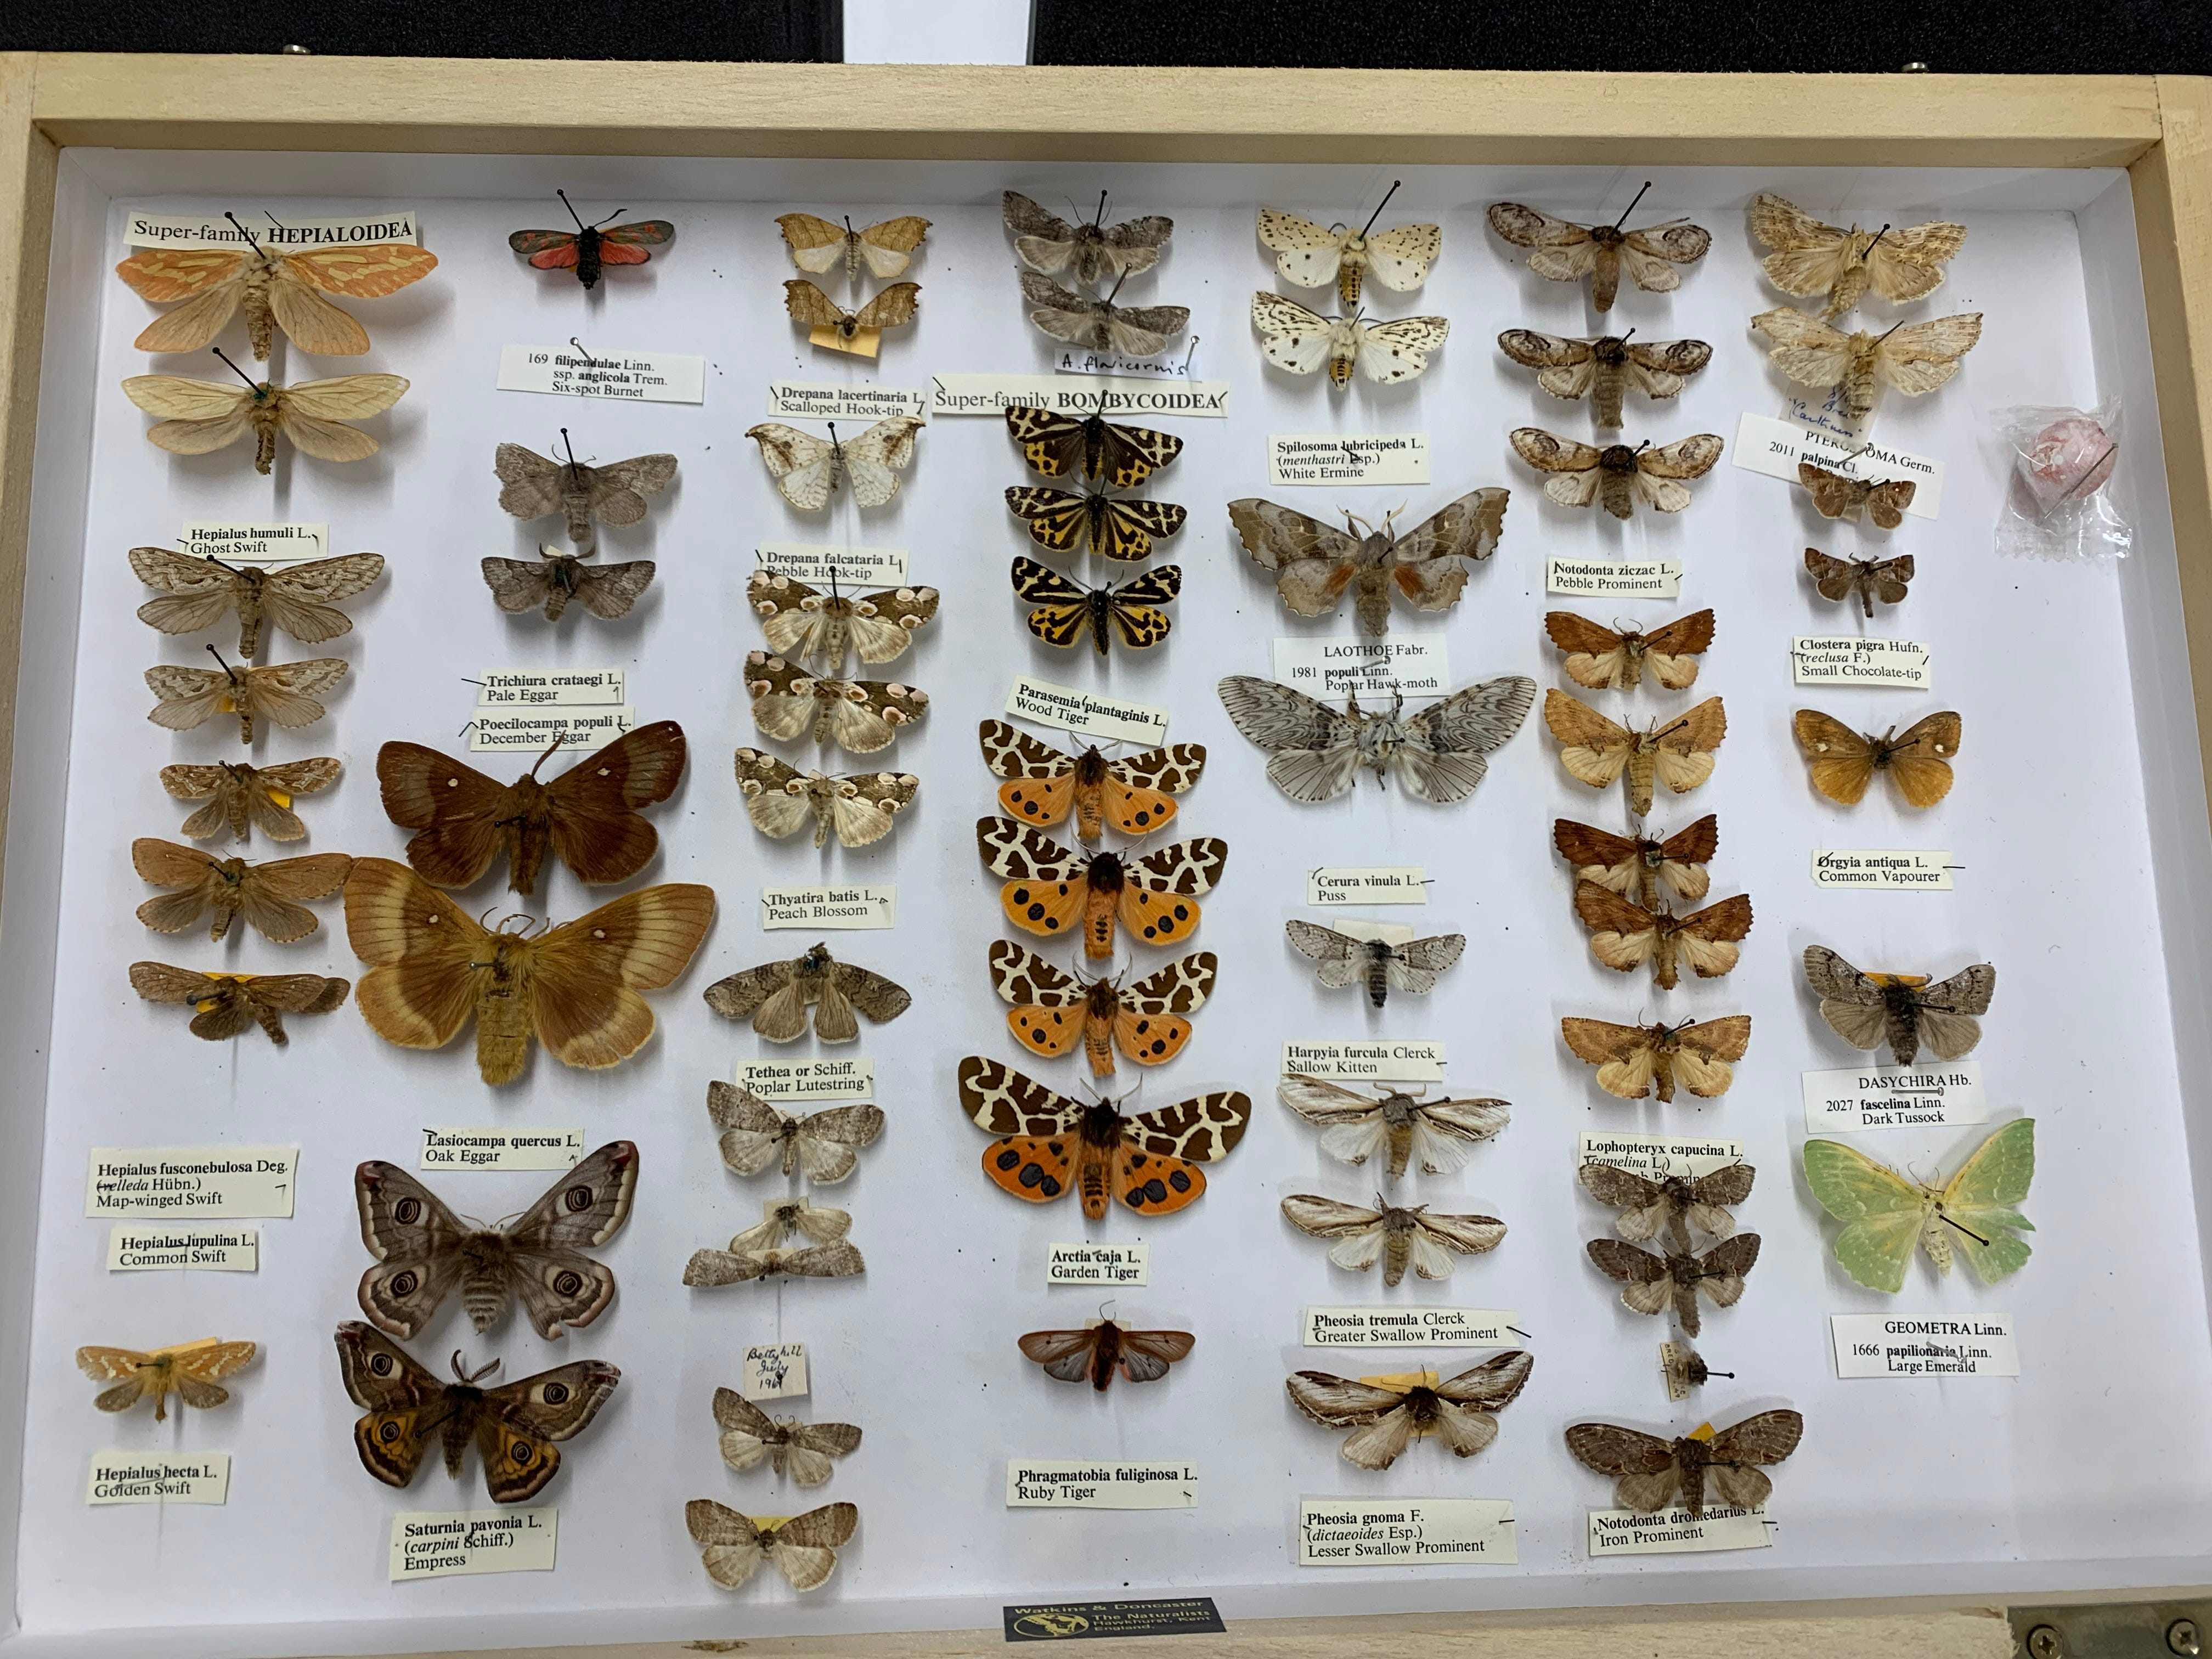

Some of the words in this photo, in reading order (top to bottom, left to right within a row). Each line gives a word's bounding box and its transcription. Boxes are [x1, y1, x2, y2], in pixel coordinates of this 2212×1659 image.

[134, 221, 261, 245] Super-family
[267, 221, 413, 244] HEPIALOIDEA
[528, 353, 548, 364] 169
[555, 355, 621, 370] filipendulae
[624, 359, 654, 371] Linn.
[554, 371, 575, 381] ssp.
[578, 371, 630, 384] anglicola
[634, 374, 667, 386] Trem.
[552, 382, 600, 396] Six-spot
[603, 386, 644, 397] Burnet
[782, 387, 833, 401] Drepana
[838, 390, 907, 403] lacertinaria
[935, 390, 1049, 410] Super-family
[1057, 392, 1219, 409] BOMBYCOIDEA
[781, 401, 841, 414] Scalloped
[847, 404, 903, 416] Hook-tip
[1278, 442, 1338, 454] Spilosoma
[1769, 442, 1794, 456] 2011
[1802, 453, 1840, 469] palpina
[1278, 455, 1345, 466] (menthastri
[1900, 456, 1935, 473] Germ.
[1278, 469, 1316, 479] White
[1320, 468, 1364, 478] Ermine
[191, 528, 247, 542] Hepialus
[250, 527, 293, 539] humuli
[190, 543, 230, 554] Ghost
[234, 541, 267, 553] Swift
[767, 552, 819, 565] Drepana
[824, 553, 884, 565] falcataria
[1554, 562, 1613, 575] Notodonta
[1619, 565, 1655, 575] ziczac
[1556, 577, 1593, 588] Pebble
[1598, 579, 1662, 589] Prominent
[1324, 646, 1392, 658] LAOTHOE
[1396, 645, 1427, 655] Fabr.
[1800, 639, 1851, 652] Clostera
[1856, 640, 1884, 654] pigra
[1889, 641, 1922, 653] Hufn.
[1854, 653, 1871, 664] F.)
[487, 675, 546, 687] Trichiura
[551, 674, 602, 686] crataegi
[1291, 667, 1317, 678] 1981
[1324, 668, 1358, 679] populi
[1802, 666, 1837, 676] Small
[1842, 665, 1921, 681] Chocolate-tip
[1367, 679, 1437, 690] Hawk-moth
[487, 690, 515, 701] Pale
[519, 689, 558, 702] Eggar
[1015, 697, 1052, 715] Wood
[1058, 708, 1089, 725] Tiger
[1018, 684, 1080, 709] Parasemia
[1085, 703, 1149, 724] plantaginis
[479, 719, 568, 732] Poecilocampa
[573, 716, 612, 730] populi
[479, 734, 546, 744] December
[1865, 857, 1910, 869] antiqua
[1318, 877, 1359, 887] Cerura
[1364, 876, 1401, 886] vinula
[1819, 872, 1877, 882] Common
[1883, 871, 1939, 883] Vapourer
[769, 894, 823, 906] Thyatira
[829, 891, 859, 904] batis
[1318, 890, 1346, 901] Puss
[769, 907, 808, 920] Peach
[813, 906, 867, 917] Blossom
[1288, 1047, 1339, 1059] Harpyia
[1345, 1047, 1388, 1058] furcula
[1393, 1047, 1435, 1059] Clerck
[746, 1066, 790, 1079] Tethea
[795, 1066, 810, 1076] or
[814, 1062, 855, 1075] Schiff.
[1288, 1061, 1331, 1073] Sallow
[1337, 1062, 1377, 1073] Kitten
[746, 1081, 791, 1094] Poplar
[795, 1078, 864, 1092] Lutestring
[1859, 1075, 1946, 1090] DASYCHIRA
[1949, 1075, 1971, 1085] Hb.
[1826, 1100, 1853, 1111] 2027
[1861, 1099, 1910, 1110] fascelina
[1914, 1097, 1945, 1108] Linn.
[1863, 1114, 1893, 1124] Dark
[1894, 1112, 1945, 1123] Tussock
[426, 1135, 505, 1147] Lasiocampa
[511, 1137, 561, 1147] quercus
[1587, 1140, 1666, 1155] Lophopteryx
[1671, 1144, 1725, 1157] capucina
[425, 1151, 454, 1162] Oak
[461, 1151, 500, 1164] Eggar
[98, 1163, 156, 1177] Hepialus
[160, 1161, 252, 1175] fusconebulosa
[256, 1160, 288, 1175] Deg.
[151, 1177, 201, 1191] Hübn.)
[97, 1194, 182, 1209] Map-winged
[185, 1192, 222, 1205] Swift
[121, 1237, 184, 1250] Hepialus
[187, 1234, 237, 1248] lupulina
[120, 1252, 188, 1266] Common
[191, 1251, 226, 1262] Swift
[1052, 1250, 1091, 1262] Arctia
[1096, 1251, 1121, 1265] caja
[1127, 1251, 1141, 1263] L.
[1052, 1266, 1099, 1278] Garden
[1104, 1266, 1139, 1280] Tiger
[1314, 1314, 1364, 1327] Pheosia
[1370, 1314, 1418, 1325] tremula
[1424, 1312, 1464, 1324] Clerck
[1314, 1330, 1365, 1342] Greater
[1370, 1329, 1425, 1341] Swallow
[1431, 1328, 1498, 1340] Prominent
[1885, 1322, 1971, 1334] GEOMETRA
[1974, 1323, 2006, 1335] Linn.
[1852, 1345, 1880, 1356] 1666
[1888, 1360, 1922, 1373] Large
[1926, 1361, 1976, 1372] Emerald
[97, 1468, 160, 1481] Hepialus
[164, 1465, 199, 1478] hecta
[1018, 1470, 1110, 1484] Phragmatobia
[1116, 1469, 1178, 1482] fuliginosa
[94, 1482, 150, 1498] Golden
[154, 1481, 191, 1494] Swift
[1018, 1487, 1055, 1500] Ruby
[1061, 1486, 1096, 1499] Tiger
[1307, 1513, 1357, 1525] Pheosia
[1362, 1513, 1404, 1525] gnoma
[1410, 1510, 1424, 1522] F.
[1598, 1516, 1666, 1532] Notodonta
[405, 1520, 465, 1537] Saturnia
[470, 1516, 522, 1533] pavonia
[1307, 1528, 1384, 1543] (dictaeoides
[1389, 1525, 1422, 1540] Esp.)
[1600, 1534, 1629, 1547] Iron
[1634, 1528, 1703, 1544] Prominent
[405, 1538, 459, 1555] (carpini
[1308, 1545, 1350, 1557] Lesser
[1355, 1543, 1410, 1556] Swallow
[1416, 1541, 1485, 1554] Prominent
[404, 1554, 466, 1571] Empress
[1014, 1606, 1087, 1614] Watkins
[1114, 1601, 1203, 1610] Doncaster
[1127, 1611, 1210, 1620] Naturalists
